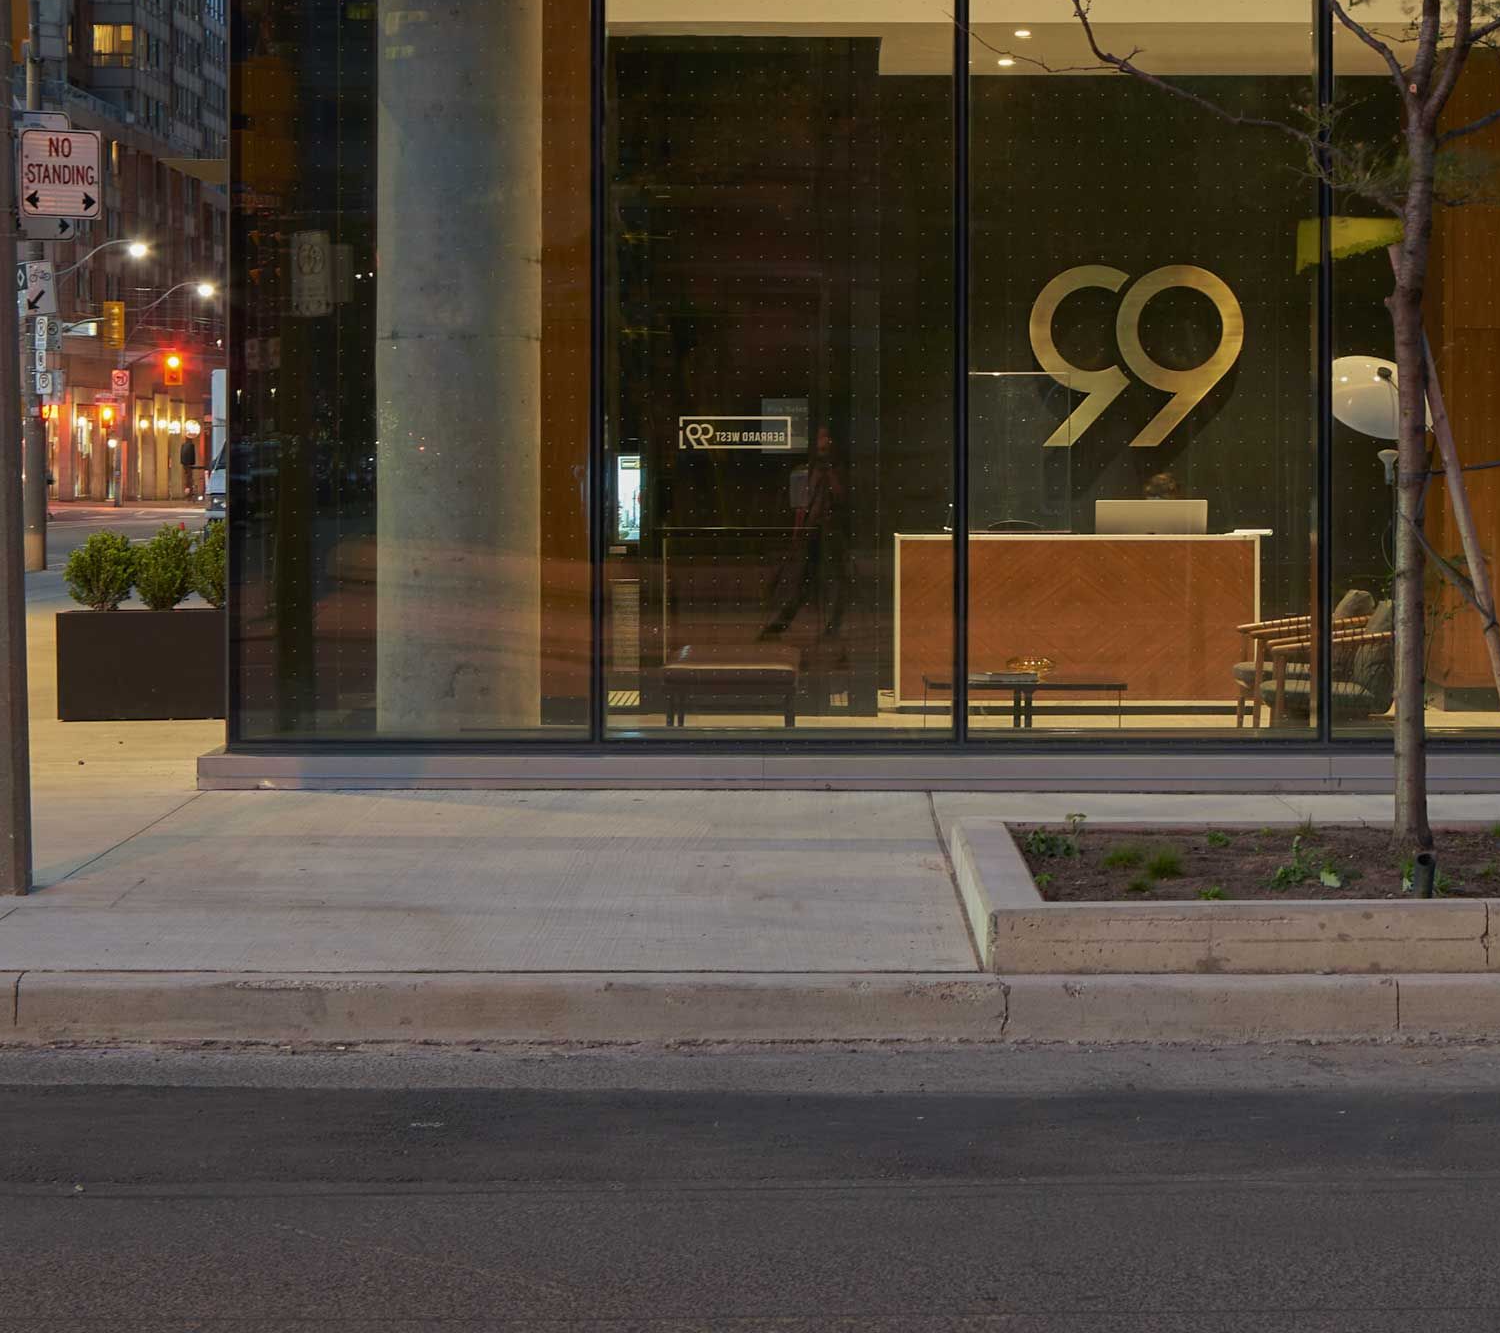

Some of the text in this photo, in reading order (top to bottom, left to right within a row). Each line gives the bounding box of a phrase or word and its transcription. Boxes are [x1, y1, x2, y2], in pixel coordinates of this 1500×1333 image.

[48, 137, 72, 158] NO
[26, 163, 95, 186] STANDING
[1029, 264, 1244, 447] 99
